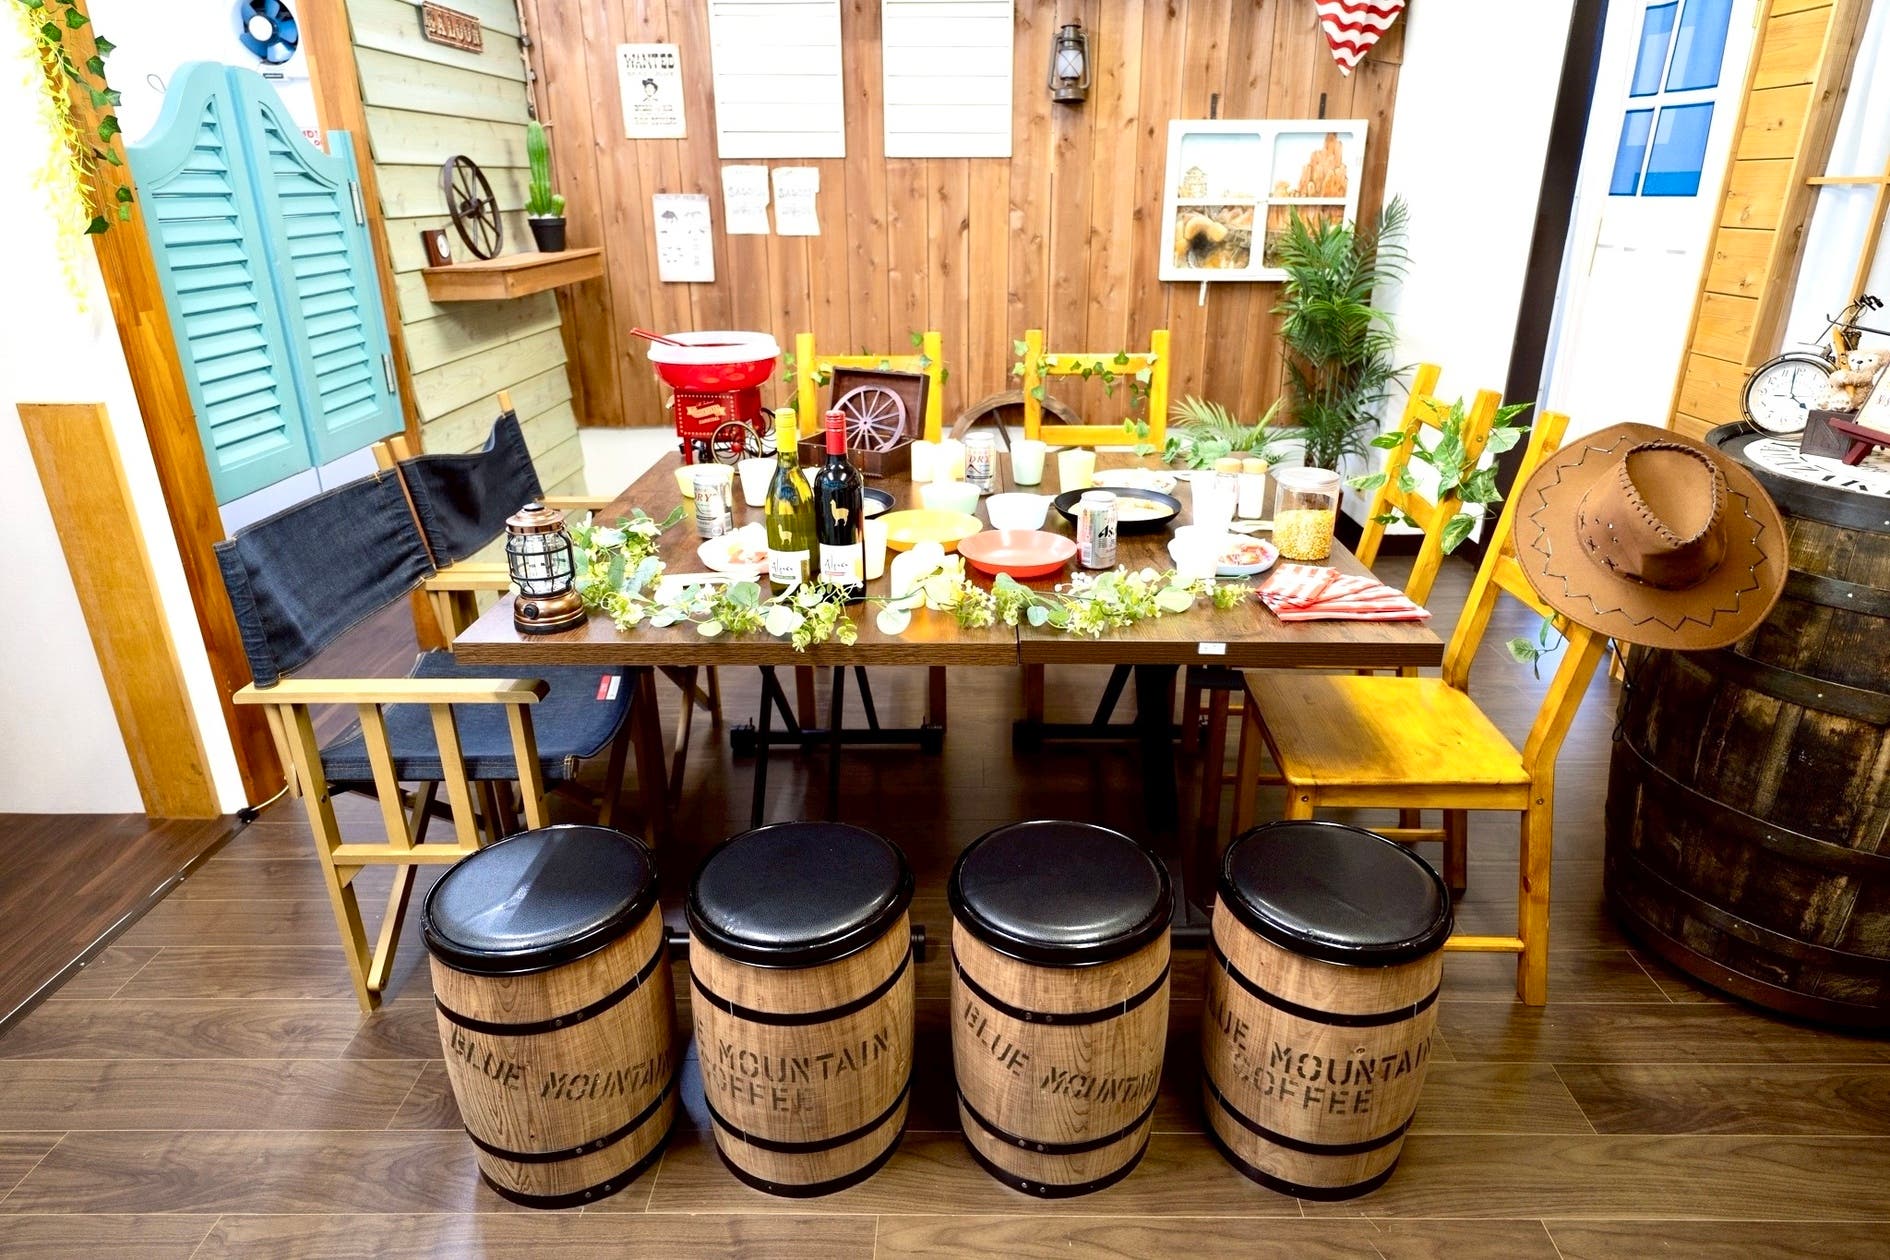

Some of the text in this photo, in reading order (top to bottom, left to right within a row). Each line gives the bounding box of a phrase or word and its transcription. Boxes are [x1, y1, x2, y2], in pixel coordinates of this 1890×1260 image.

[623, 53, 675, 69] WANTED
[451, 1025, 527, 1091] BLUE
[719, 1028, 888, 1083] MOUNTAIN
[964, 1001, 1030, 1077] BLUE
